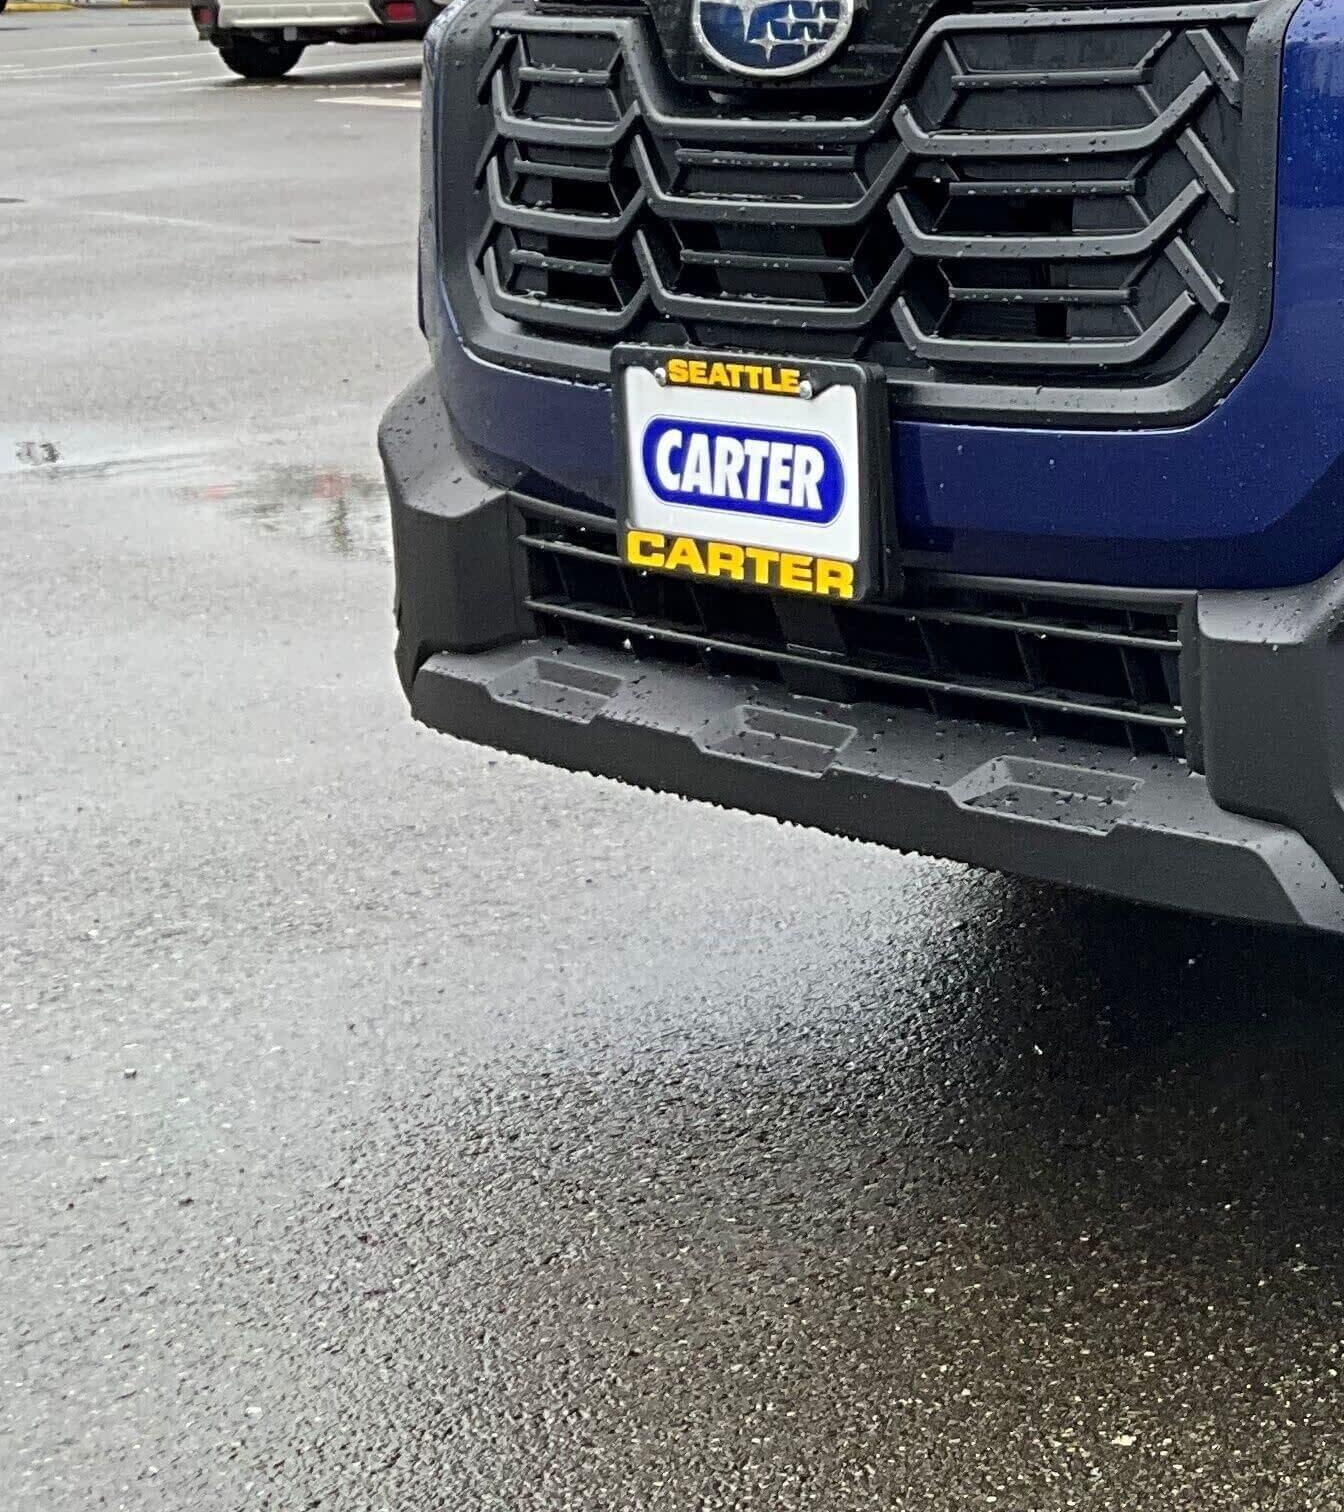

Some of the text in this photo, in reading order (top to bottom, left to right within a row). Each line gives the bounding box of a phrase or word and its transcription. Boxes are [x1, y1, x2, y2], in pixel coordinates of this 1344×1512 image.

[667, 358, 801, 394] SEATTLE
[656, 428, 825, 510] CARTER
[626, 529, 855, 600] CARTER
